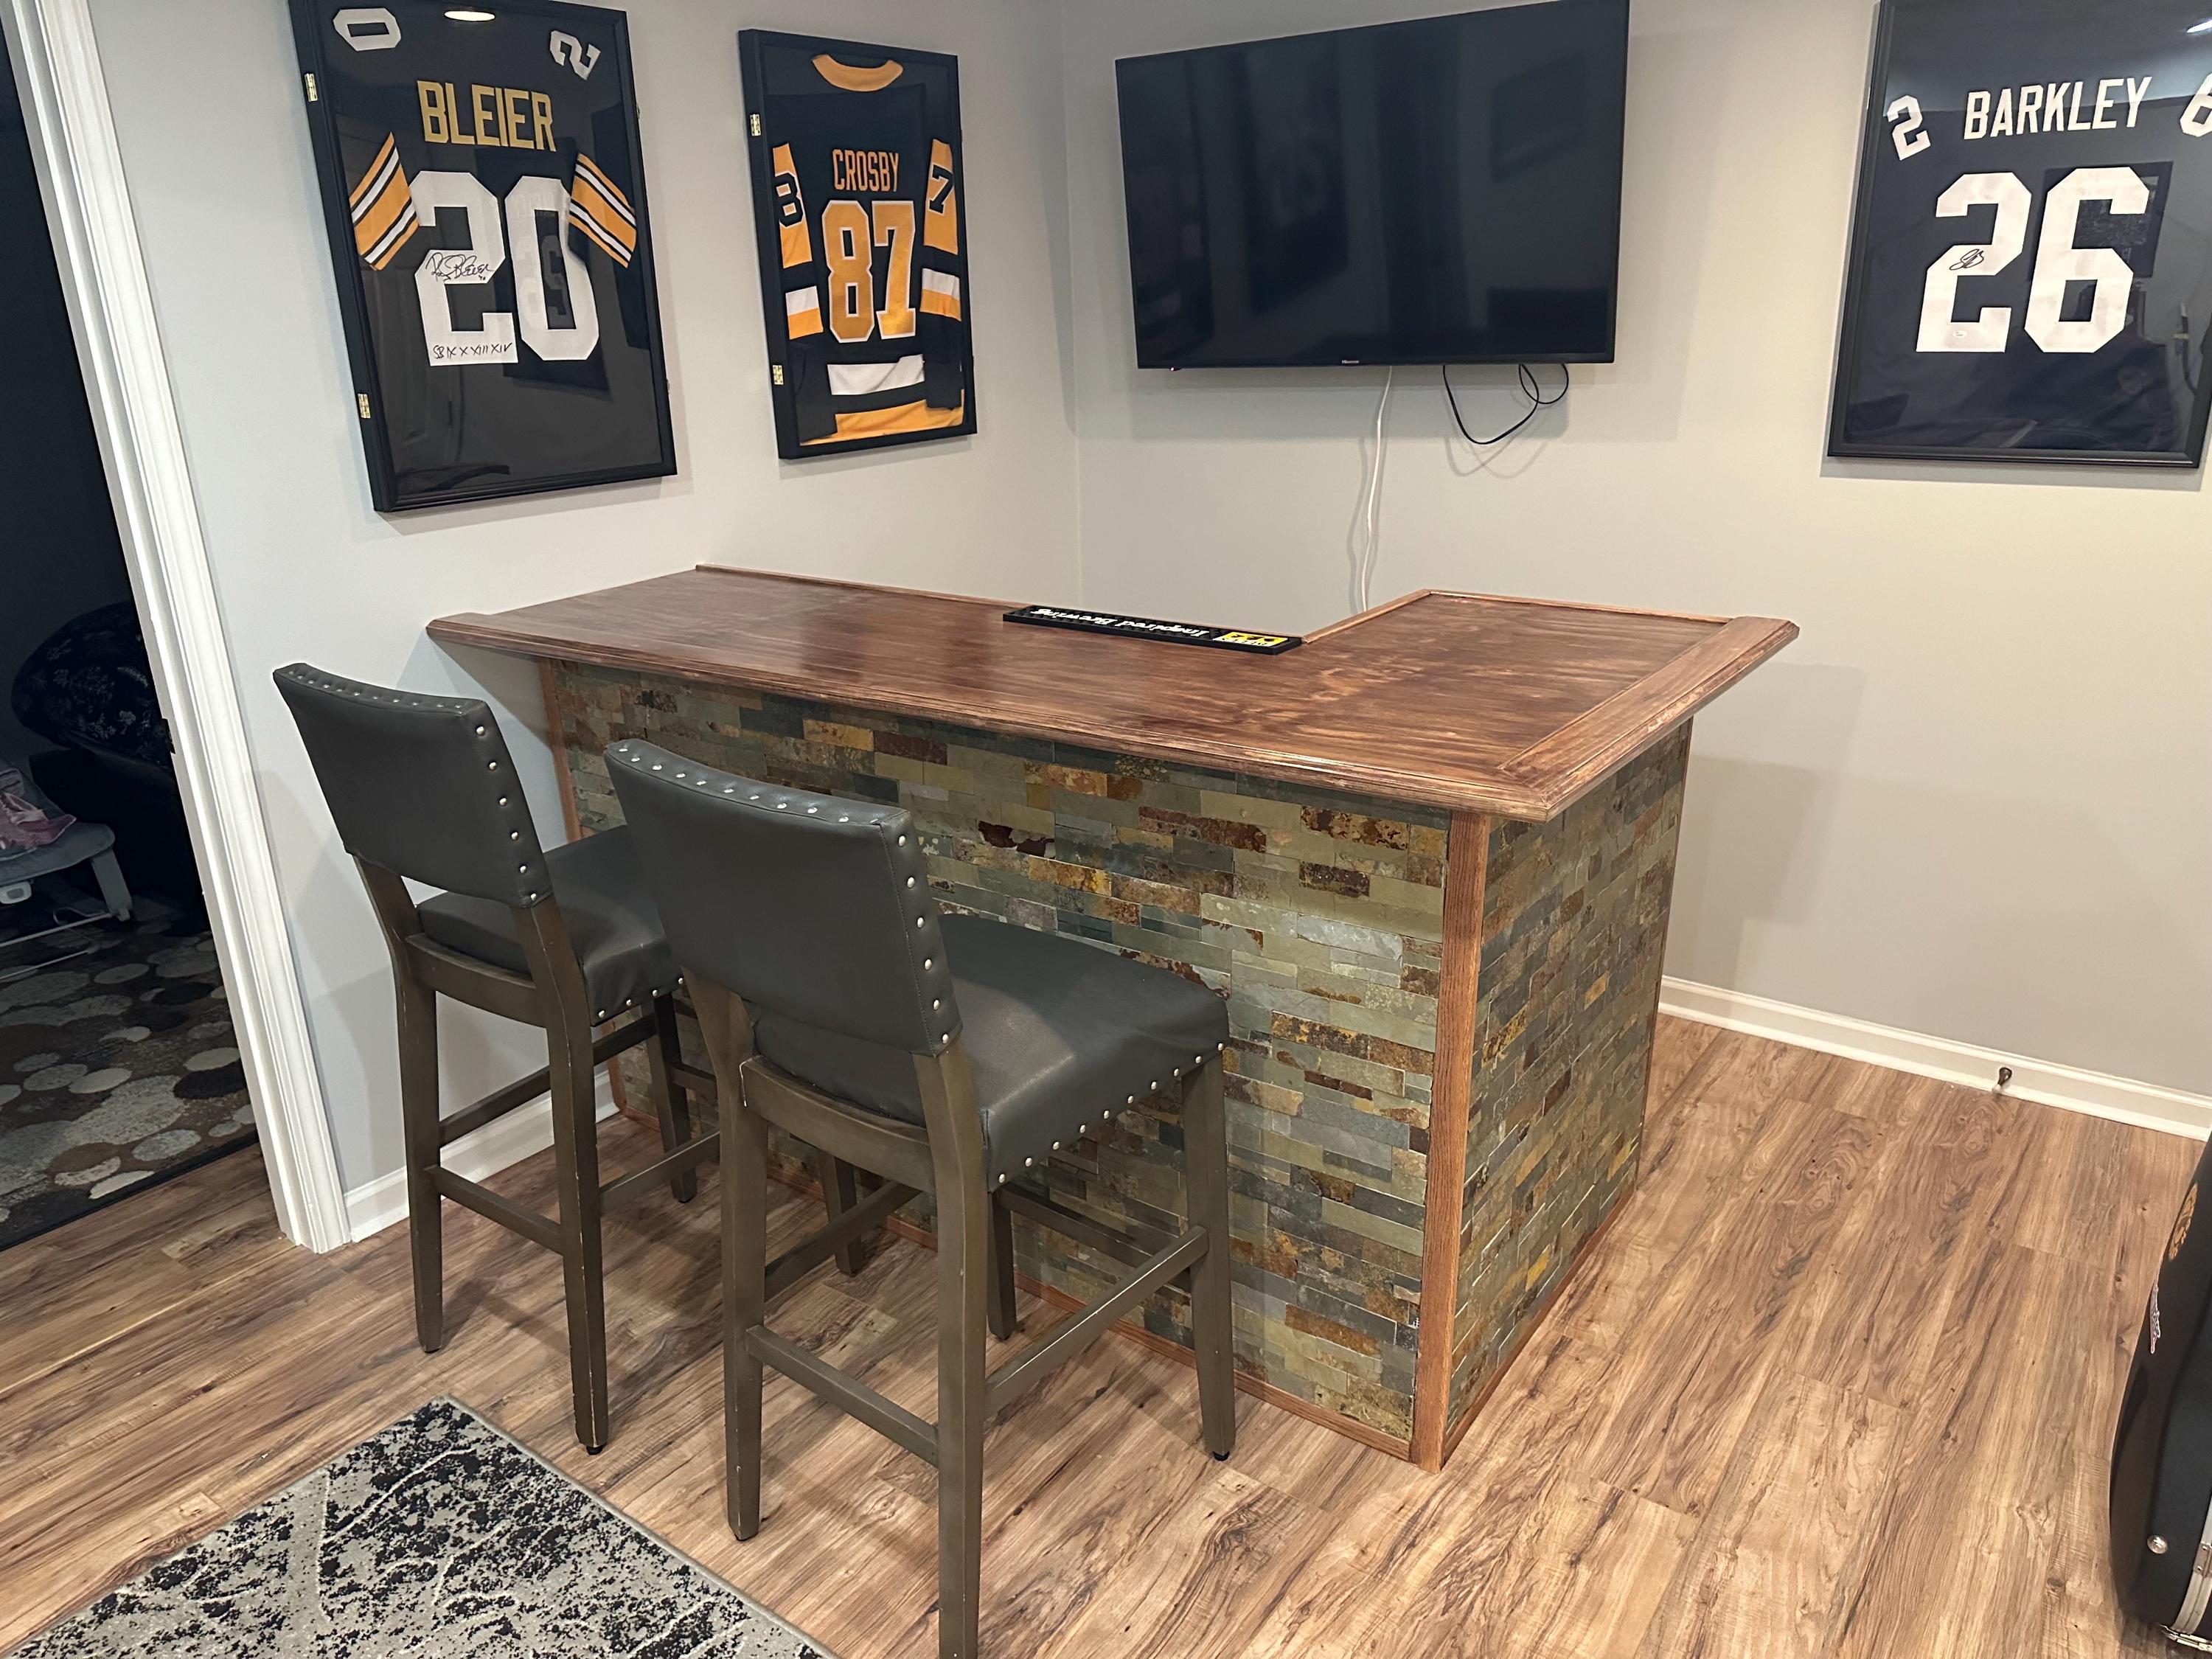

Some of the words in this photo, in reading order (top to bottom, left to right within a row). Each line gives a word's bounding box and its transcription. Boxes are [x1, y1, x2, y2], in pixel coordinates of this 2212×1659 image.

[417, 80, 556, 152] BLEIER
[1887, 95, 1931, 161] 2
[1964, 77, 2152, 139] BARKLEY
[775, 171, 804, 229] 8
[832, 149, 900, 192] CROSBY
[928, 164, 955, 214] 7
[409, 171, 599, 366] 20
[821, 200, 916, 343] 87
[1916, 167, 2150, 353] 26
